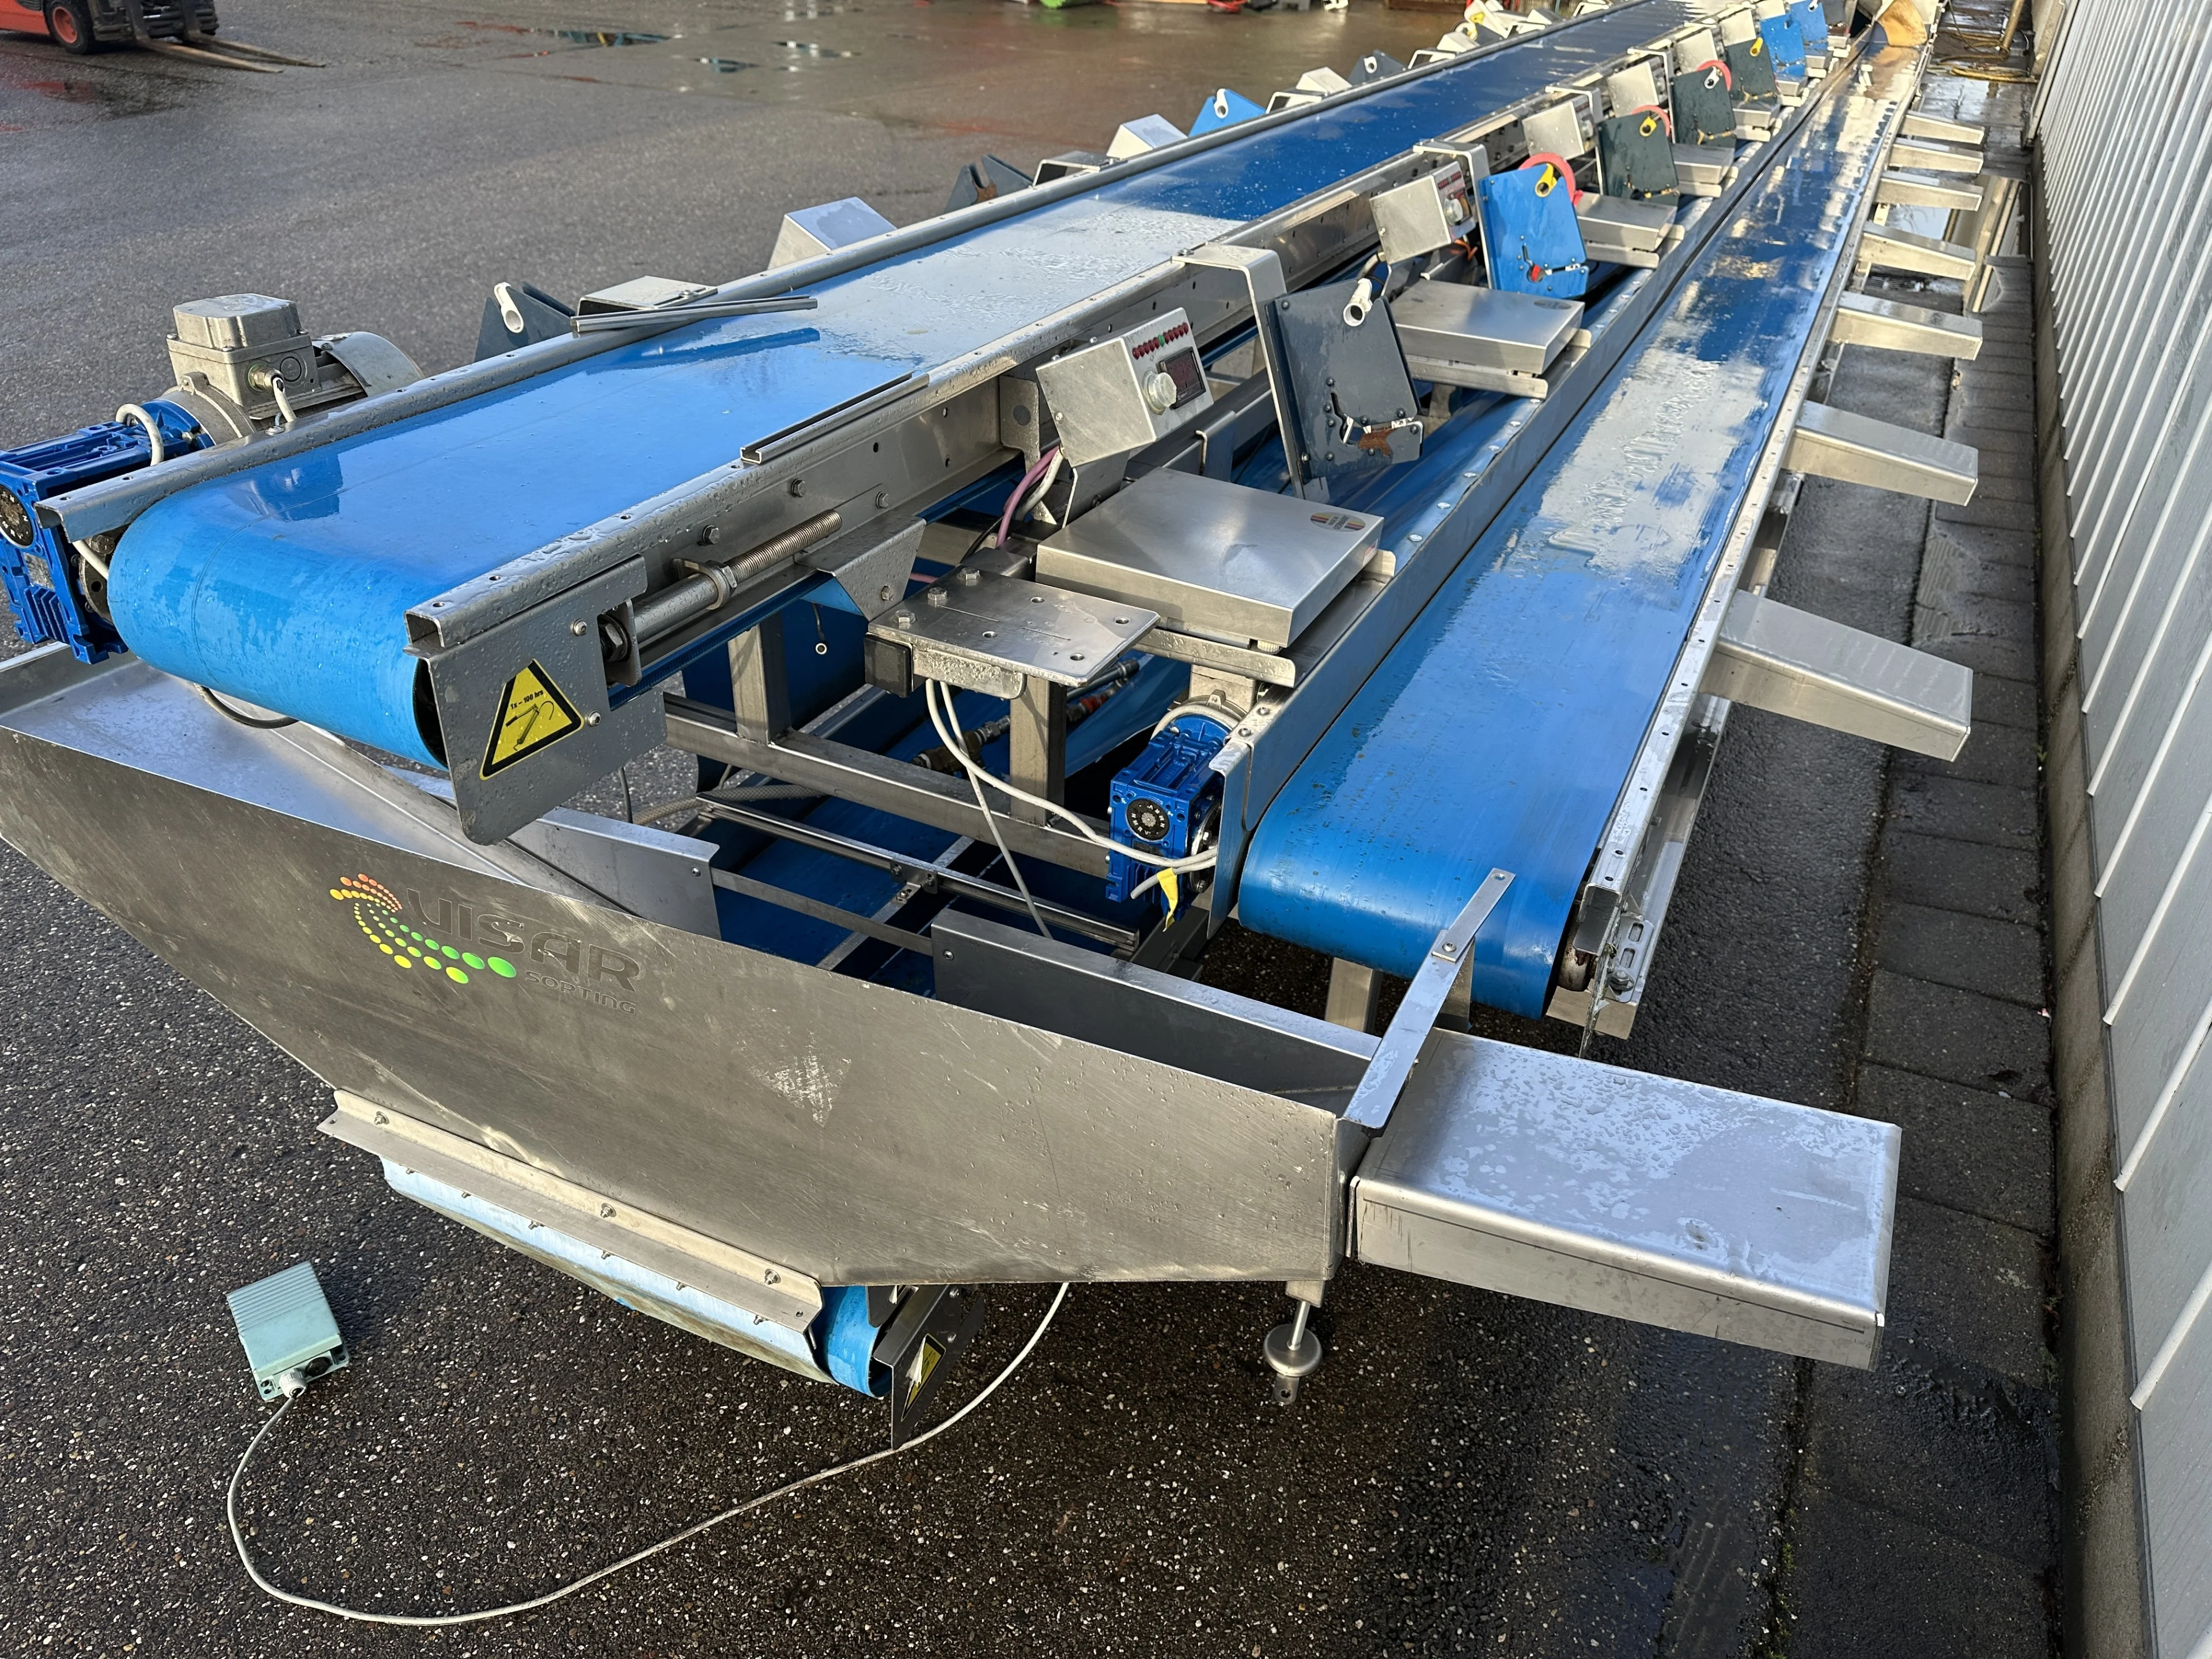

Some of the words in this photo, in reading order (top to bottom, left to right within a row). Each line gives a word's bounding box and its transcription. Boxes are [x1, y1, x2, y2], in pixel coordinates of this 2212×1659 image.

[523, 694, 533, 703] 100
[534, 690, 543, 698] hrs
[407, 888, 645, 992] VISAR
[525, 970, 637, 1014] SORTING
